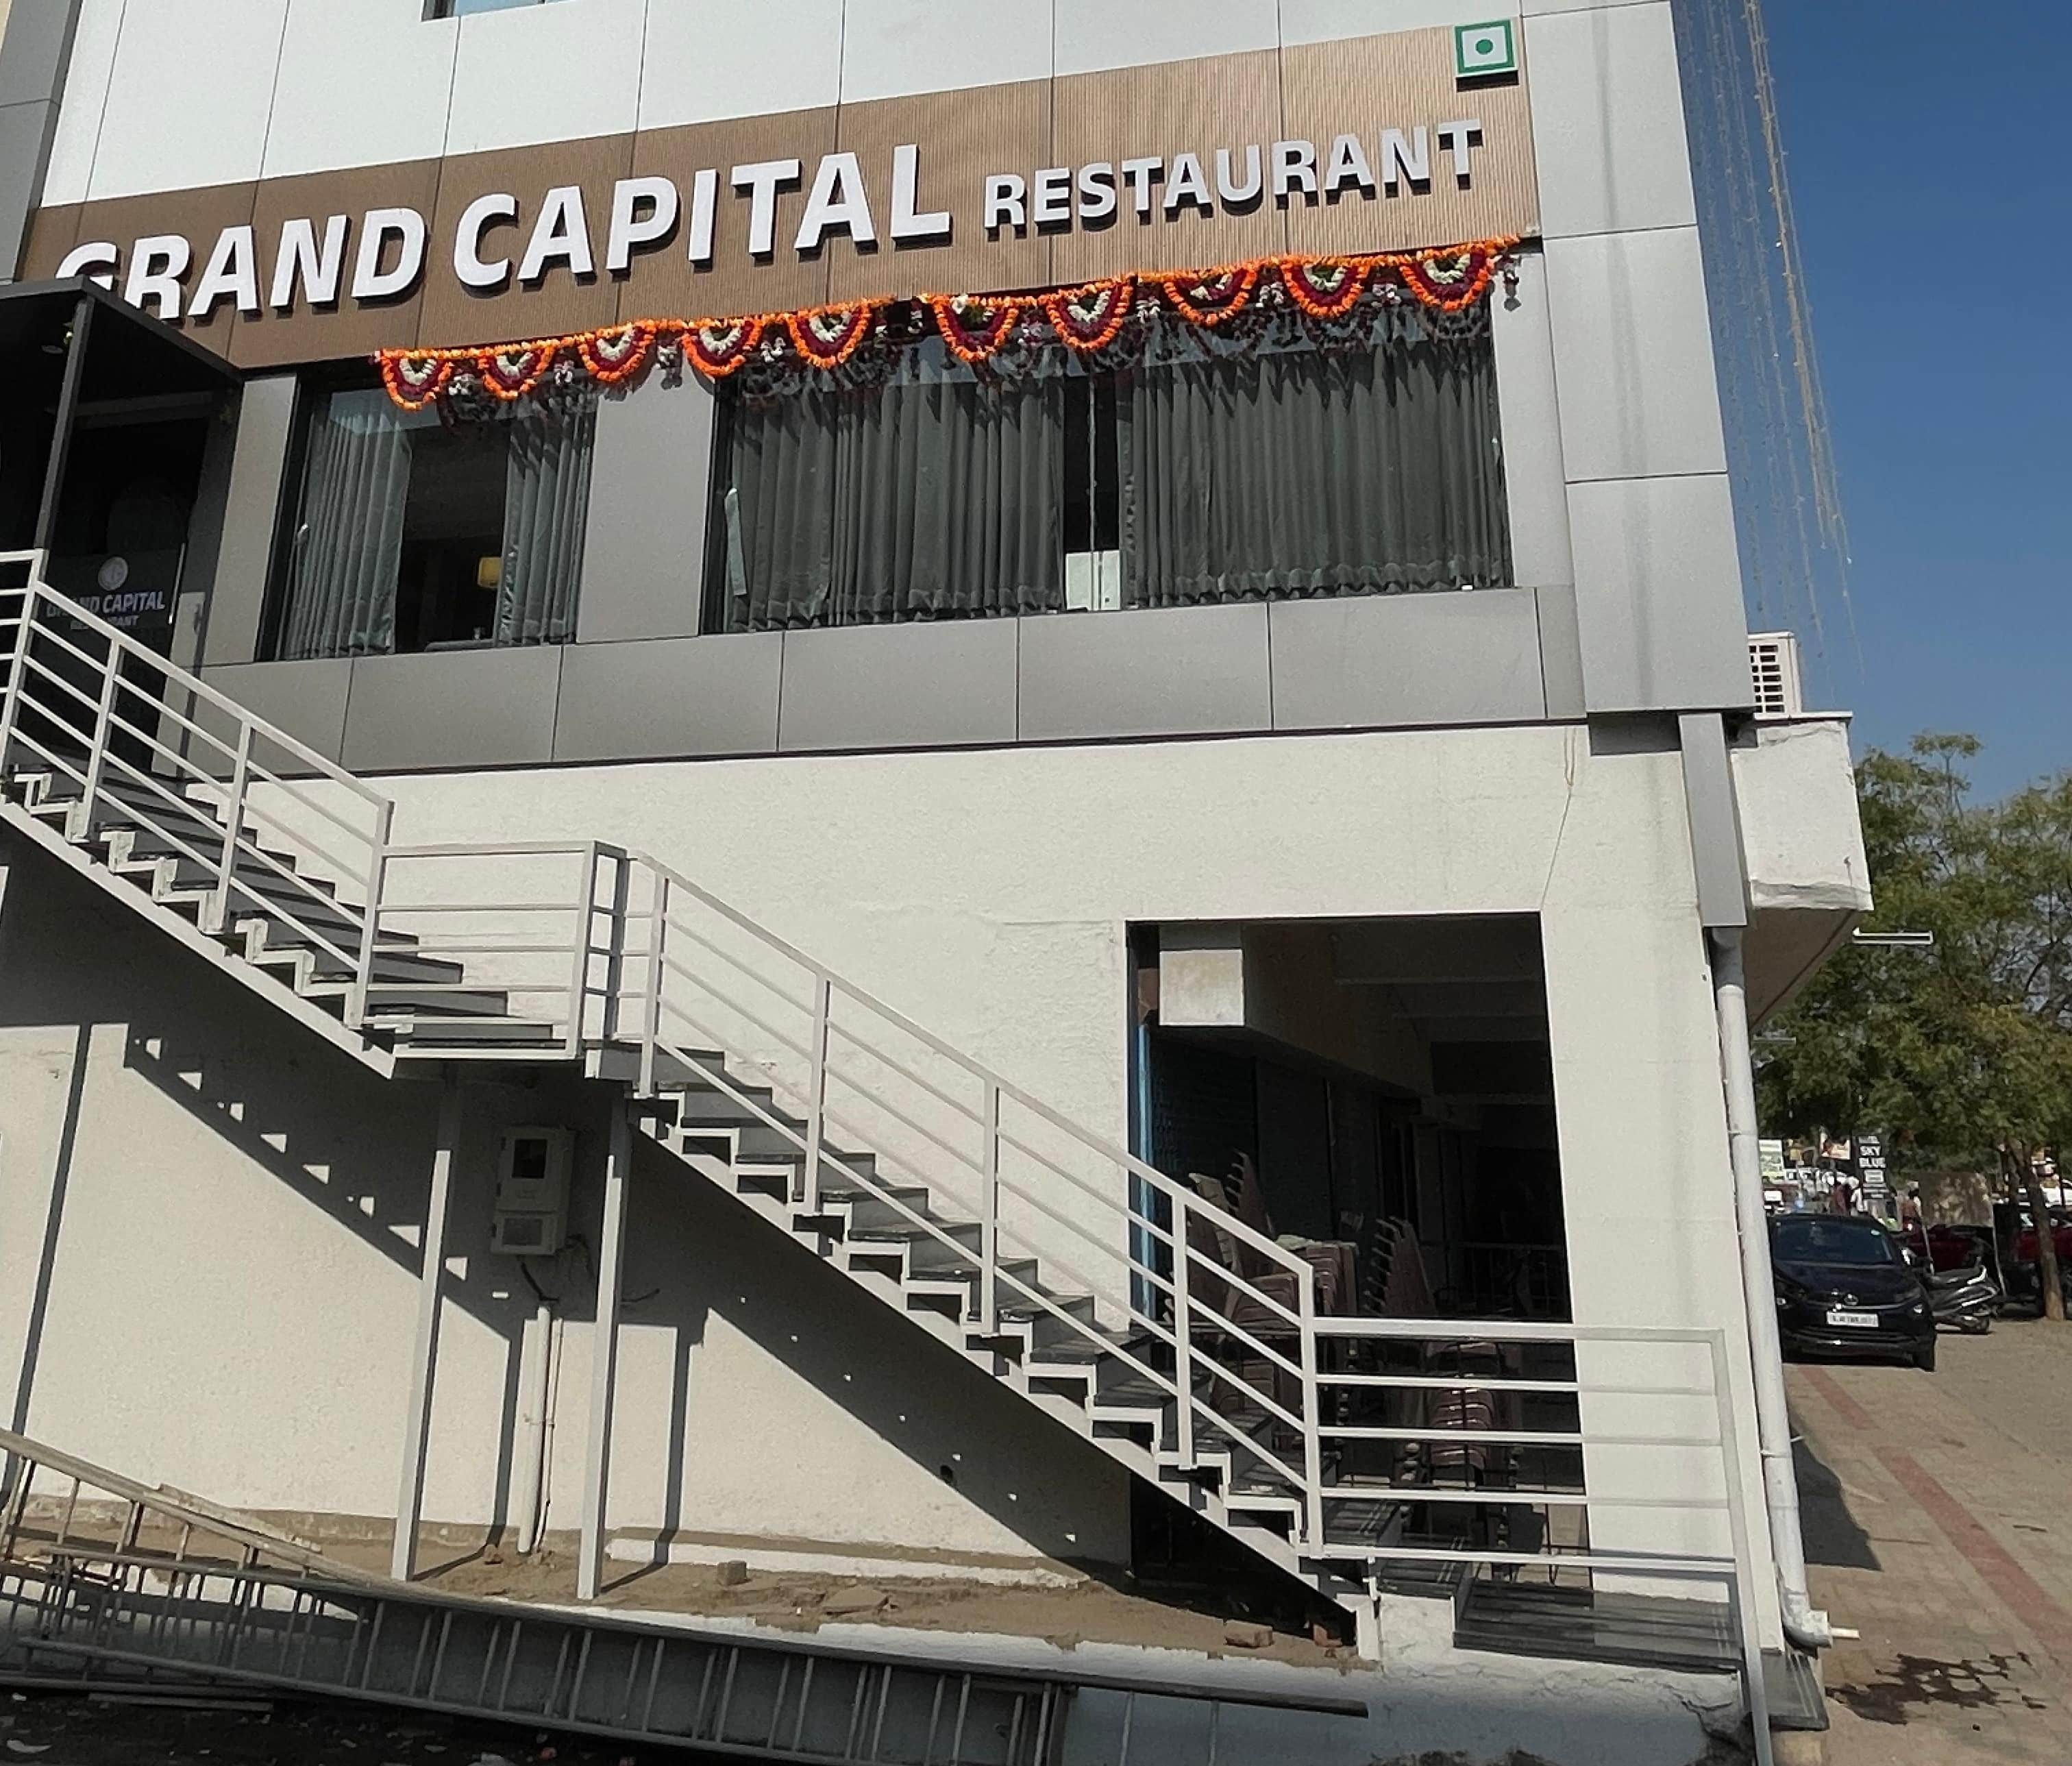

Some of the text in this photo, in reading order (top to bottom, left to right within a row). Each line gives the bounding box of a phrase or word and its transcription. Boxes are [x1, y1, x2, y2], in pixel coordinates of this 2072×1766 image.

[55, 120, 1481, 319] GRAND CAPITAL RESTAURANT
[103, 591, 165, 613] CAPITAL
